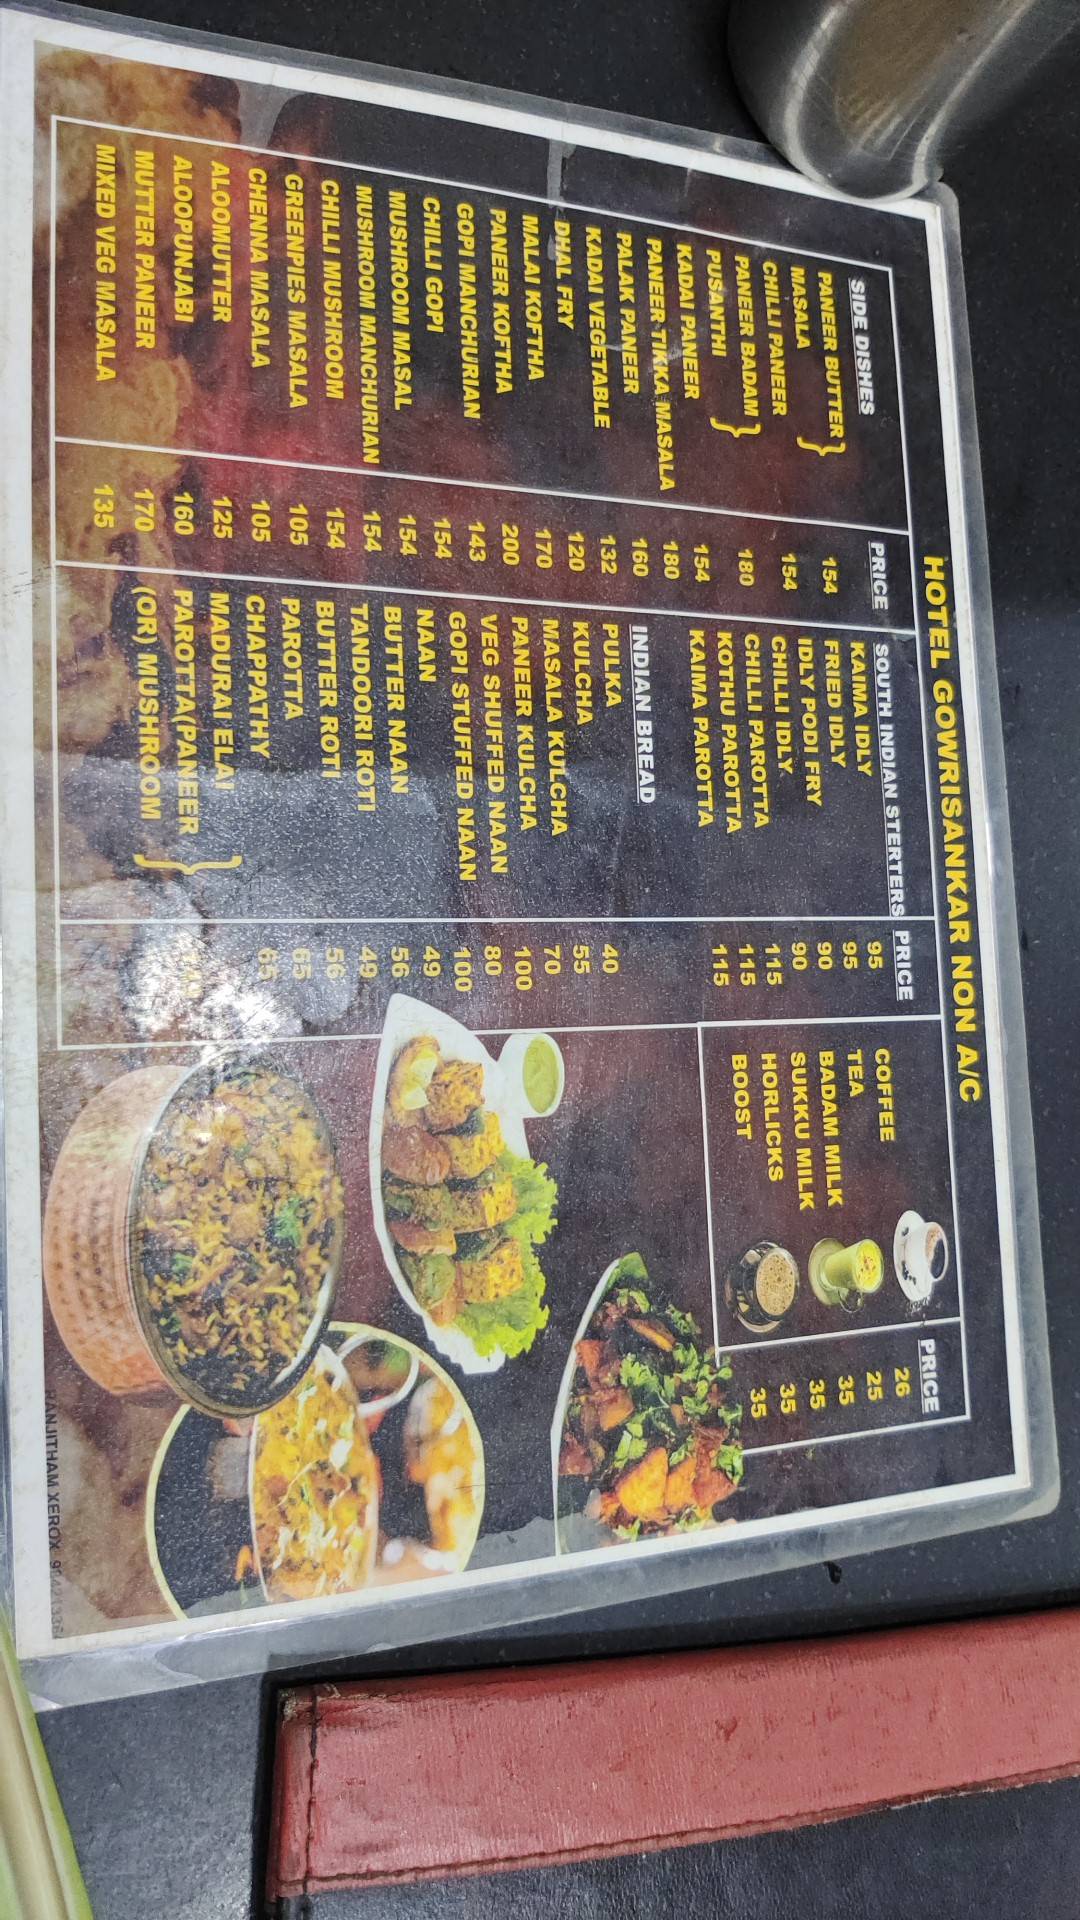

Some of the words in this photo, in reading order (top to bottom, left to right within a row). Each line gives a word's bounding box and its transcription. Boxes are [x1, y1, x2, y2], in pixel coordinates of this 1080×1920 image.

[95, 143, 117, 219] MIXED
[136, 150, 154, 246] MUTTER
[247, 167, 269, 264] CHENNA
[95, 224, 117, 274] VEG
[172, 153, 194, 323] ALOOPUNJABI
[209, 159, 233, 323] ALOOMUTTER
[285, 173, 307, 304] GREENPIES
[320, 180, 341, 254] CHILLI
[357, 185, 376, 309] MUSHROOM
[423, 196, 443, 270] CHILLI
[457, 202, 475, 257] GOPI
[523, 214, 541, 285] MALAI
[555, 220, 572, 278] DHAL
[389, 191, 410, 325] MUSHROOM
[491, 208, 509, 297] PANEER
[586, 226, 604, 294] KADAI
[618, 232, 635, 302] PALAK
[647, 238, 666, 323] PANEER
[677, 243, 695, 310] KADAI
[134, 252, 156, 349] PANEER
[250, 269, 271, 368] MASALA
[426, 276, 444, 333] GOPI
[558, 285, 574, 328] FRY
[706, 249, 727, 357] PUSANTHI
[736, 255, 755, 336] PANEER
[763, 260, 782, 328] CHILLI
[791, 266, 811, 349] MASALA
[819, 271, 838, 352] PANEER
[850, 278, 866, 329] SIDE
[95, 280, 117, 382] MASALA
[288, 310, 309, 408] MASALA
[323, 260, 345, 400] MUSHROOM
[460, 263, 481, 419] MANCHURIAN
[494, 302, 513, 394] KOFTHA
[526, 289, 545, 380] KOFTHA
[589, 300, 611, 428] VEGETABLE
[622, 308, 640, 394] PANEER
[652, 329, 670, 395] TIKKA
[681, 314, 700, 399] PANEER
[360, 314, 380, 464] MANCHURIAN
[394, 330, 413, 410] MASAL
[741, 341, 759, 417] BADAM
[769, 332, 788, 416] PANEER
[825, 356, 845, 438] BUTTER
[854, 336, 874, 414] DISHES
[656, 400, 676, 490] MASALA
[94, 484, 114, 528] 135
[133, 488, 158, 534] 170
[174, 492, 195, 536] 160
[213, 496, 233, 539] 125
[251, 501, 272, 542] 105
[289, 503, 309, 545] 105
[327, 508, 346, 549] 154
[363, 512, 383, 551] 154
[399, 516, 418, 555] 154
[434, 519, 453, 559] 154
[469, 522, 487, 561] 143
[501, 523, 520, 566] 200
[536, 529, 553, 569] 170
[568, 533, 586, 572] 120
[601, 536, 618, 574] 132
[633, 538, 649, 577] 160
[663, 542, 680, 580] 180
[695, 544, 711, 582] 154
[739, 549, 755, 586] 180
[783, 554, 798, 590] 154
[823, 559, 838, 593] 154
[869, 542, 888, 609] PRICE
[134, 586, 159, 644] (OR)
[417, 608, 437, 682] NAAN
[449, 610, 469, 674] GOPI
[481, 613, 500, 667] VEG
[924, 556, 951, 668] HOTEL
[209, 592, 233, 719] MADURAI
[246, 594, 270, 757] CHAPPATHY
[282, 598, 304, 719] PAROTTA
[316, 601, 339, 707] BUTTER
[351, 604, 374, 741] TANDOORI
[384, 606, 406, 710] BUTTER
[511, 616, 533, 716] PANEER
[543, 619, 564, 722] MASALA
[574, 621, 594, 725] KULCHA
[603, 623, 622, 707] PULKA
[632, 625, 651, 712] INDIAN
[690, 629, 708, 709] KAIMA
[718, 631, 736, 716] KOTHU
[745, 633, 763, 712] CHILLI
[772, 635, 790, 713] CHILLI
[798, 638, 815, 689] IDLY
[826, 639, 842, 708] FRIED
[851, 641, 869, 717] KAIMA
[874, 643, 891, 717] SOUTH
[138, 654, 161, 817] MUSHROOM
[214, 728, 234, 790] ELAI
[320, 716, 341, 777] ROTI
[389, 719, 409, 792] NAAN
[451, 683, 474, 799] STUFFED
[483, 674, 505, 793] SHUFFED
[776, 721, 793, 773] IDLY
[802, 697, 819, 753] PODI
[830, 715, 847, 767] IDLY
[856, 725, 873, 775] IDLY
[357, 749, 375, 810] ROTI
[518, 725, 538, 830] KULCHA
[548, 730, 569, 835] KULCHA
[637, 721, 656, 803] BREAD
[694, 716, 714, 827] PAROTTA
[722, 724, 742, 833] PAROTTA
[749, 719, 770, 827] PAROTTA
[807, 761, 822, 805] FRY
[879, 724, 897, 798] INDIAN
[459, 807, 477, 881] NAAN
[490, 801, 508, 873] NAAN
[933, 679, 972, 943] GOWRISANKAR
[886, 805, 904, 917] STERTERS
[258, 948, 275, 979] 65
[293, 948, 309, 979] 65
[326, 946, 343, 979] 56
[360, 946, 376, 978] 49
[392, 946, 409, 977] 56
[423, 946, 440, 977] 49
[456, 949, 472, 991] 100
[486, 946, 504, 976] 80
[515, 947, 533, 991] 100
[546, 945, 561, 975] 70
[574, 946, 591, 974] 55
[604, 944, 619, 973] 40
[714, 945, 730, 986] 115
[740, 945, 756, 986] 115
[767, 945, 783, 986] 115
[793, 943, 808, 971] 90
[818, 943, 833, 970] 90
[844, 941, 858, 969] 95
[869, 942, 884, 970] 95
[893, 930, 913, 1000] PRICE
[952, 955, 977, 1032] NON
[732, 1054, 753, 1139] BOOST
[791, 1051, 811, 1140] SUKKU
[819, 1050, 839, 1137] BADAM
[848, 1049, 865, 1097] TEA
[876, 1048, 896, 1140] COFFEE
[957, 1044, 982, 1101] A/C
[762, 1053, 784, 1182] HORLICKS
[797, 1147, 815, 1210] MILK
[826, 1144, 844, 1206] MILK
[751, 1390, 767, 1419] 35
[780, 1386, 797, 1414] 35
[810, 1381, 826, 1409] 35
[839, 1377, 855, 1406] 35
[867, 1372, 884, 1401] 25
[895, 1369, 911, 1397] 26
[919, 1340, 939, 1414] PRICE
[48, 1492, 60, 1550] XEROX
